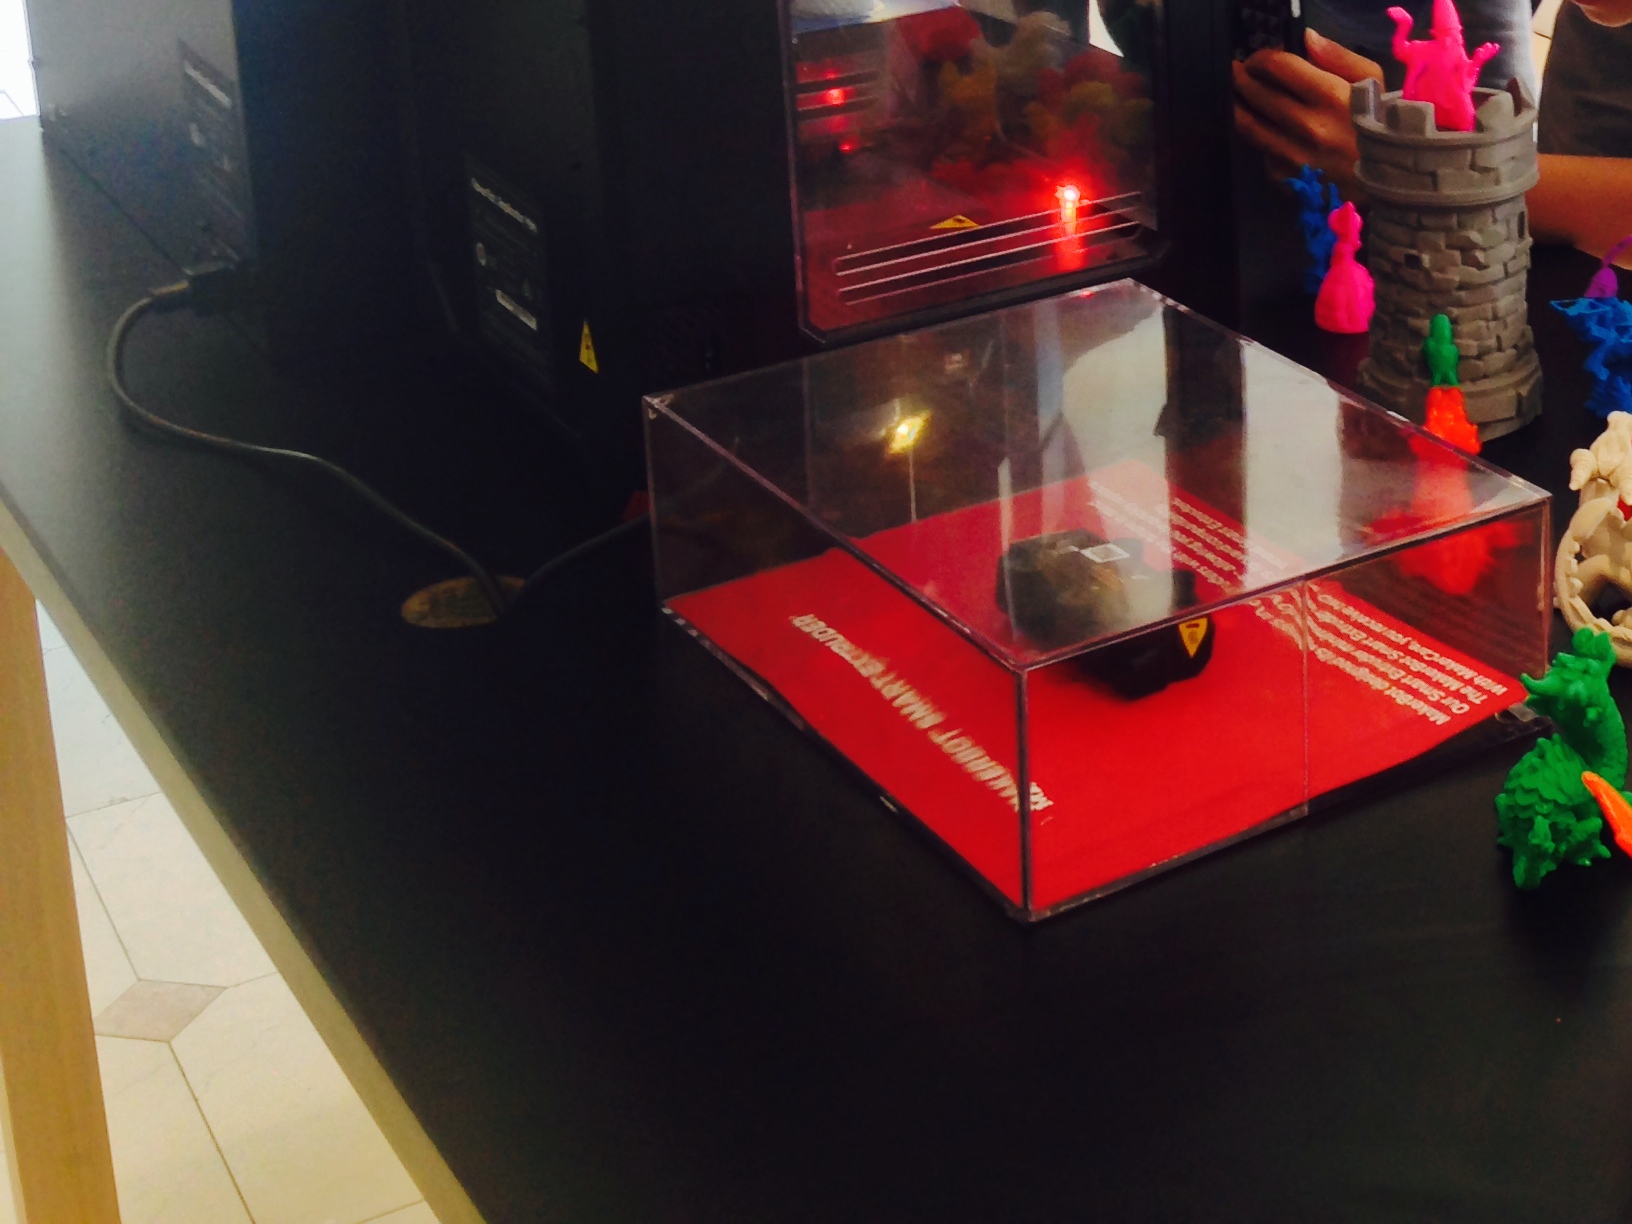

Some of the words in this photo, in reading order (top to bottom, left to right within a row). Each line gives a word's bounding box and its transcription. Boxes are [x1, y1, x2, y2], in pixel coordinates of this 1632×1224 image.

[1399, 675, 1443, 701] Smart
[1456, 685, 1488, 704] The
[1472, 675, 1507, 695] With
[1437, 696, 1470, 715] Our
